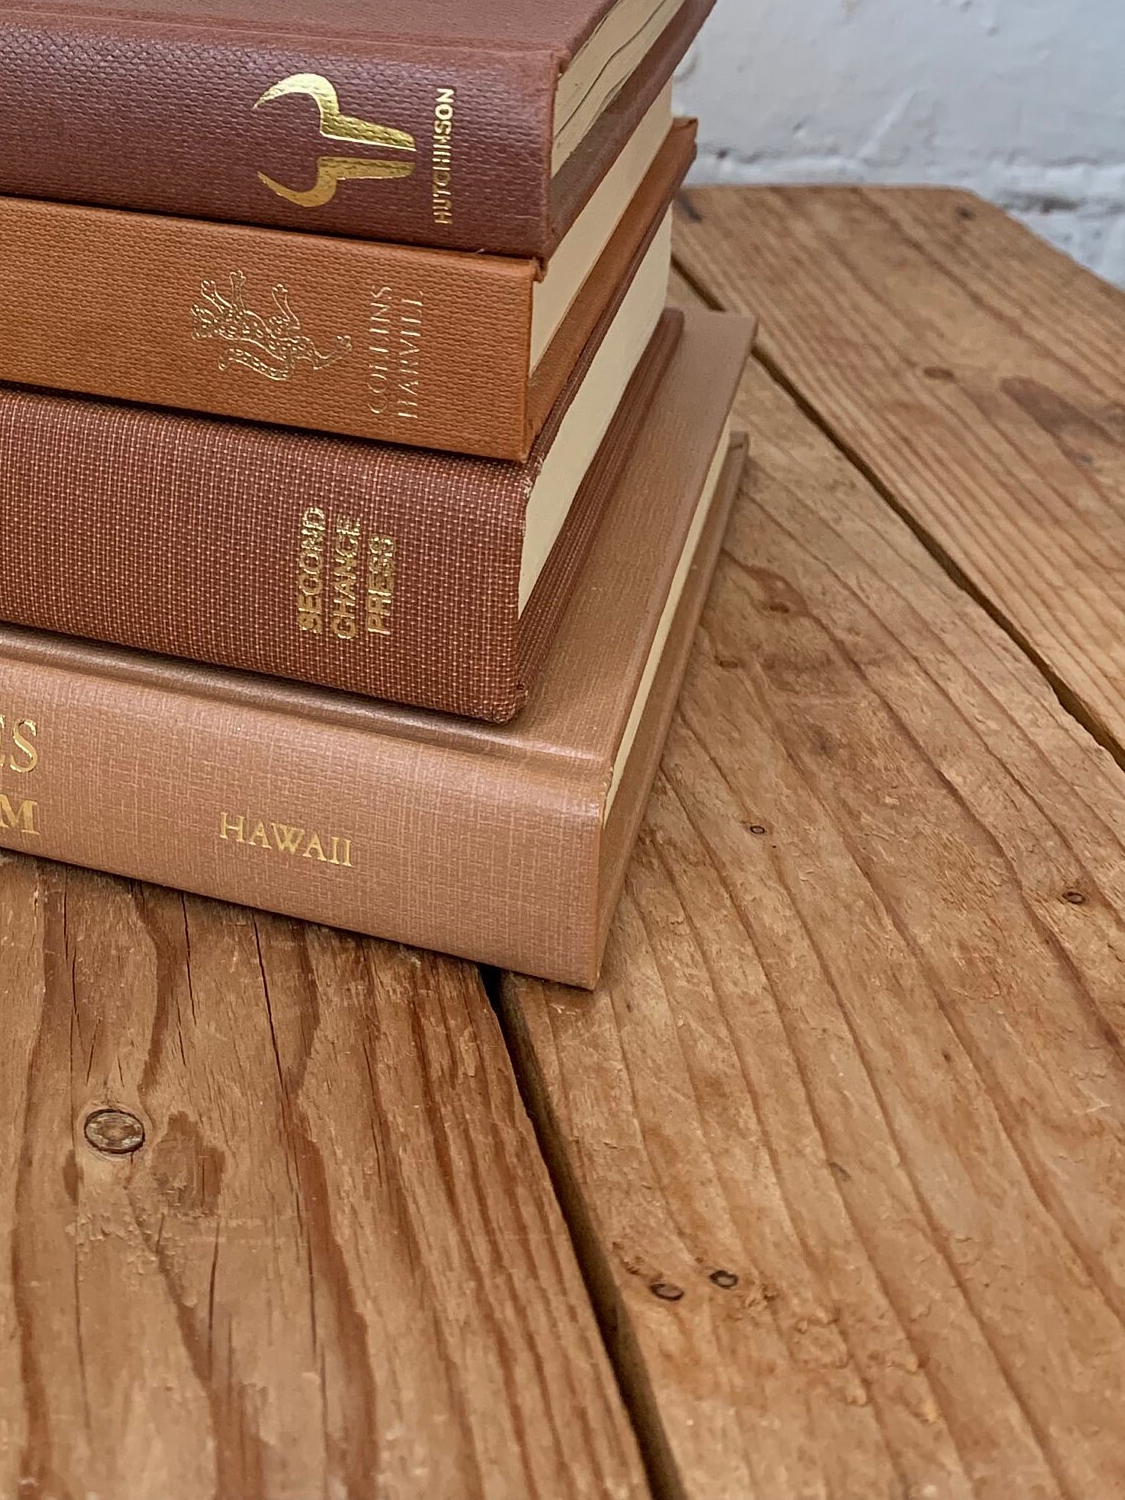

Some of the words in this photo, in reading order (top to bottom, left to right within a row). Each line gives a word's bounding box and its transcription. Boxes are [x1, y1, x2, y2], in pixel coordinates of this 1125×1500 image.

[431, 87, 455, 225] HUTCHINSON
[367, 285, 393, 415] COLLINS
[397, 289, 424, 419] HARVILL
[298, 506, 325, 635] SECOND
[331, 512, 360, 639] CHANCE
[368, 535, 396, 635] PRESS
[219, 810, 354, 868] HAWAII
